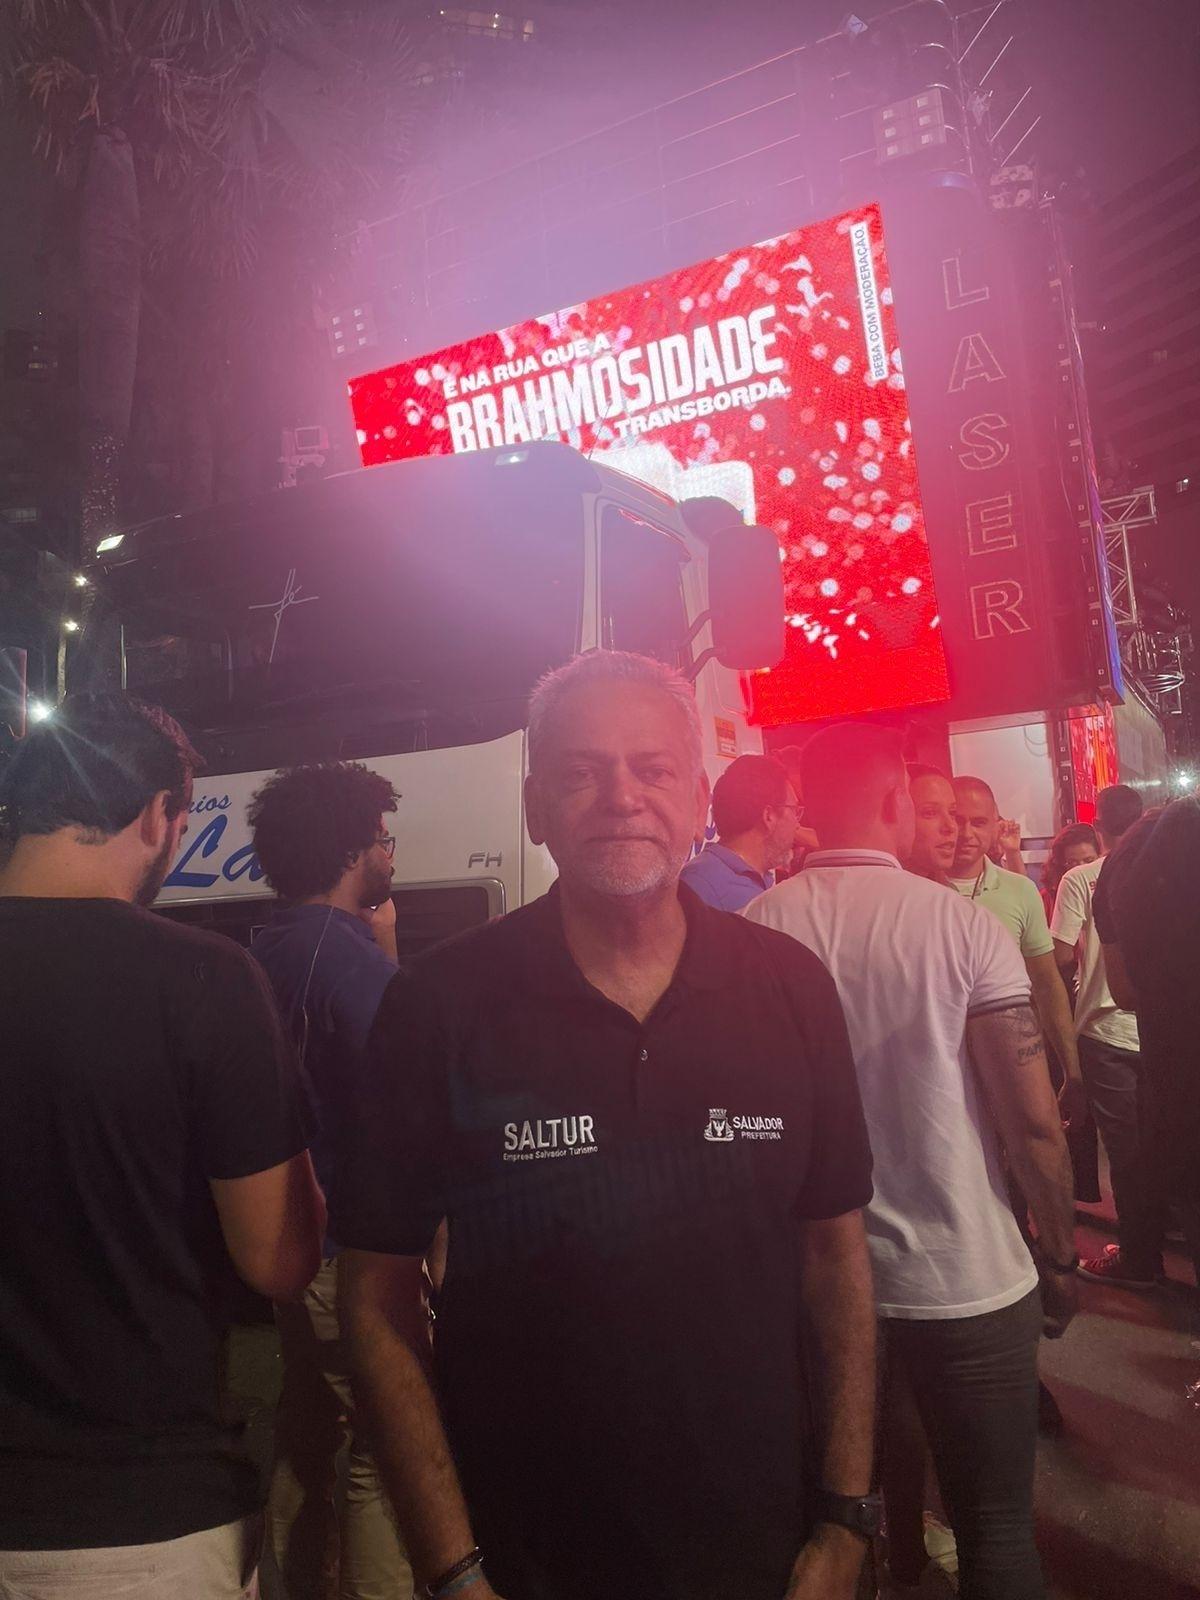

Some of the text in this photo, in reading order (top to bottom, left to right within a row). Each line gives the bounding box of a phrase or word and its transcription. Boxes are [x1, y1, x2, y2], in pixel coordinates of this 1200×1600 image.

[867, 312, 880, 342] COM
[459, 370, 492, 394] NA
[493, 354, 539, 384] RUA
[541, 338, 589, 367] QUE
[593, 332, 612, 352] A
[872, 344, 885, 377] BEBA
[446, 304, 784, 454] BRAHMOSIDADE
[942, 256, 1031, 640] LASER
[468, 851, 502, 868] FH
[504, 1115, 595, 1151] SALTUR
[732, 1115, 785, 1130] SALVADOR
[741, 1131, 782, 1140] PREFEITURA
[535, 1148, 567, 1159] Salvador
[568, 1145, 598, 1156] Turismo
